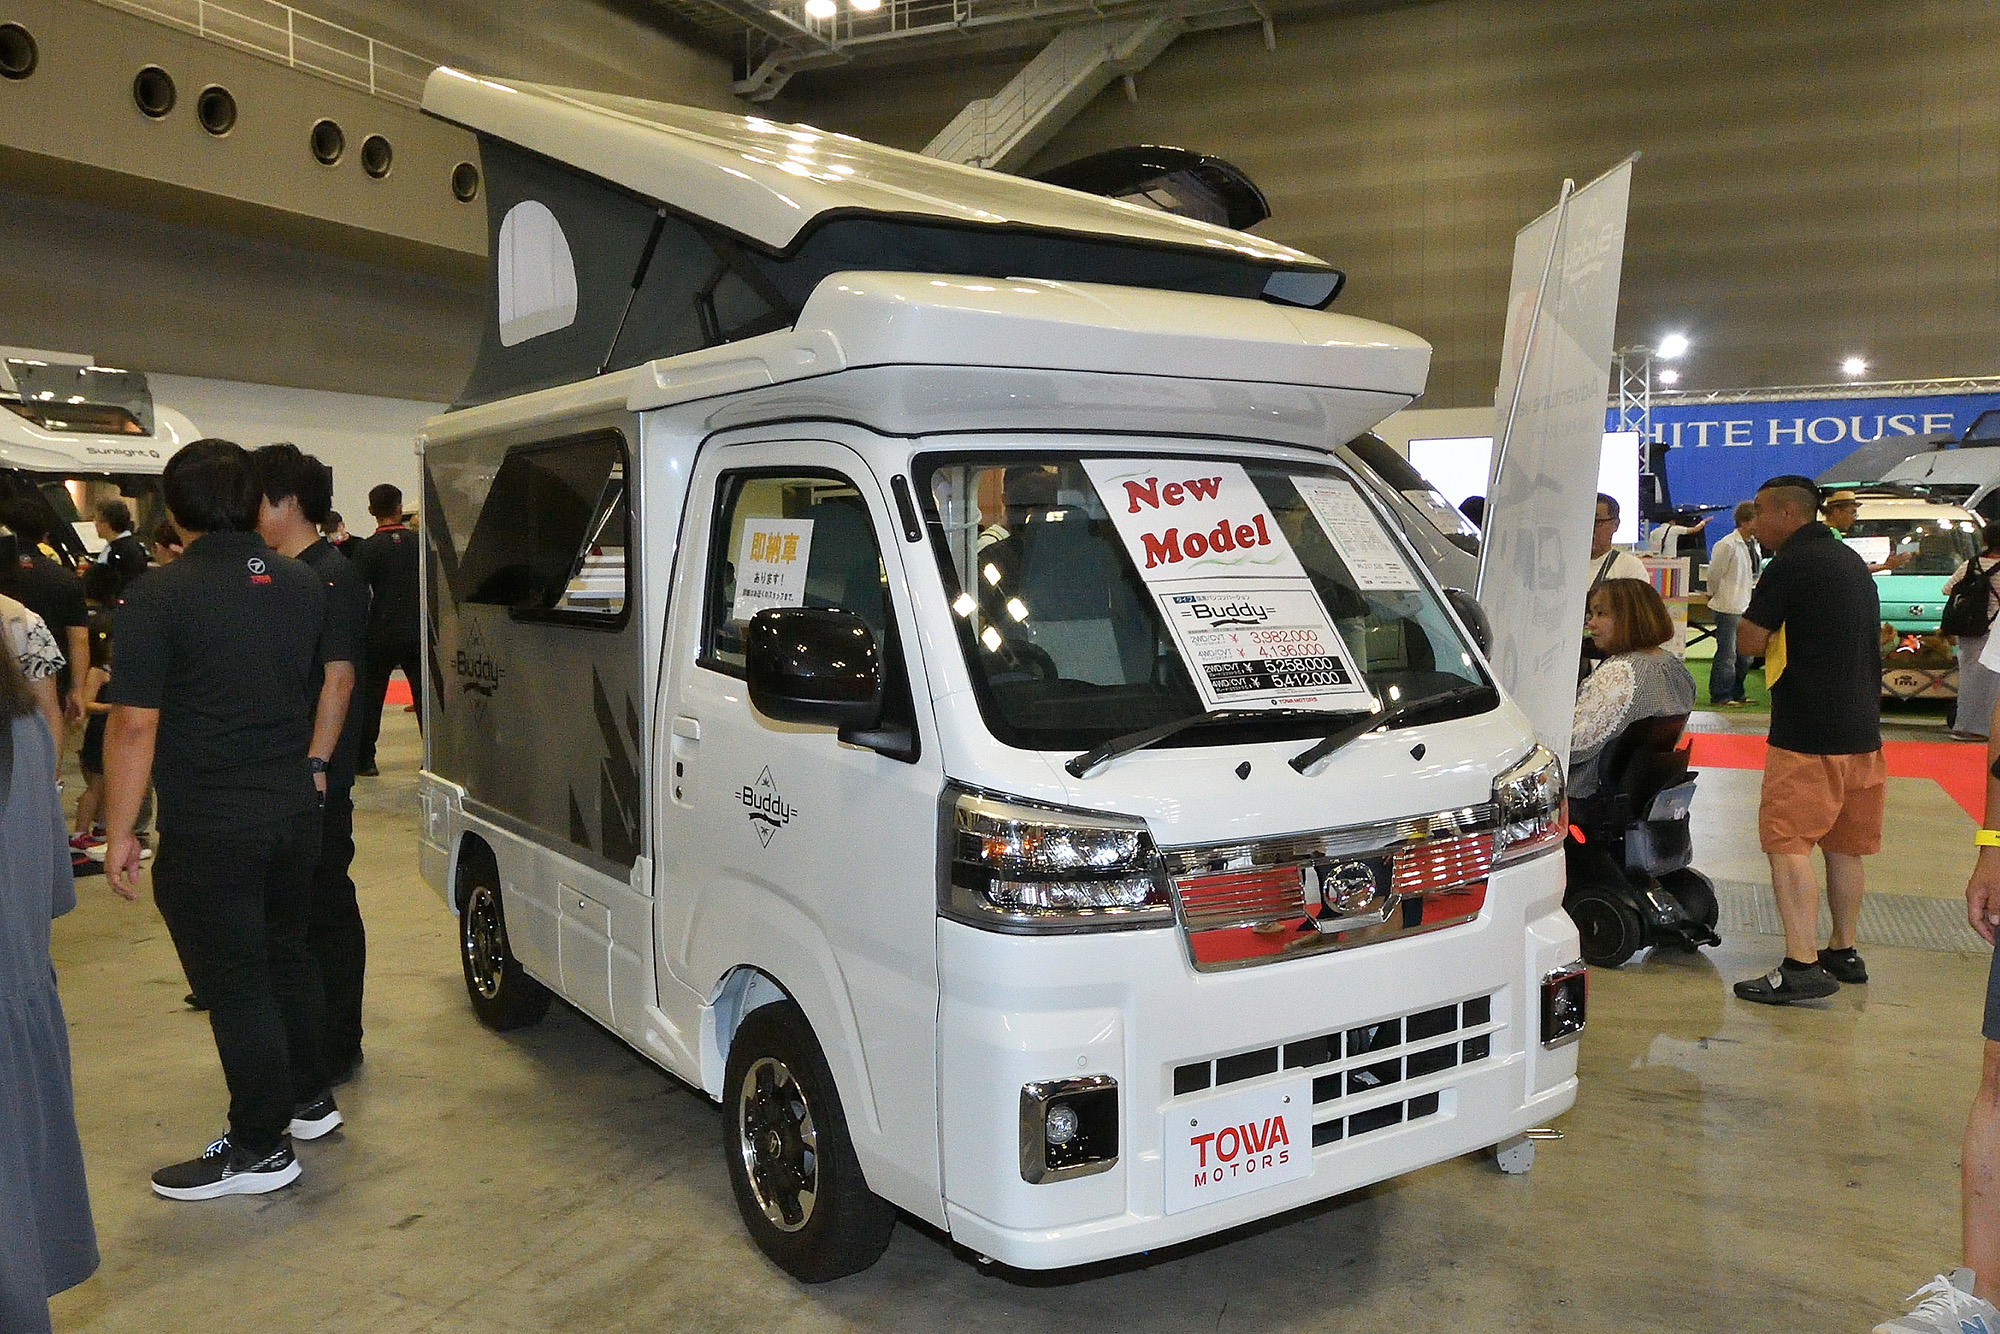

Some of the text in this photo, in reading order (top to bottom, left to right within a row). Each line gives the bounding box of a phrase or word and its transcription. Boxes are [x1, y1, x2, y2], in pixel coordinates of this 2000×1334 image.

[1767, 413, 1954, 446] HOUSE
[86, 447, 149, 457] Sunlight
[1122, 476, 1222, 513] New
[1140, 513, 1271, 569] Model
[1191, 602, 1268, 620] Buddy
[1250, 629, 1318, 644] 3,982,000
[1259, 643, 1326, 658] 4,136,000
[457, 650, 499, 690] Buddy
[1263, 657, 1333, 673] 5,258,000
[1271, 671, 1341, 688] 5,412,000
[742, 785, 790, 824] Buddy
[1190, 1115, 1290, 1168] TOWA
[1194, 1150, 1290, 1187] MOTORS
